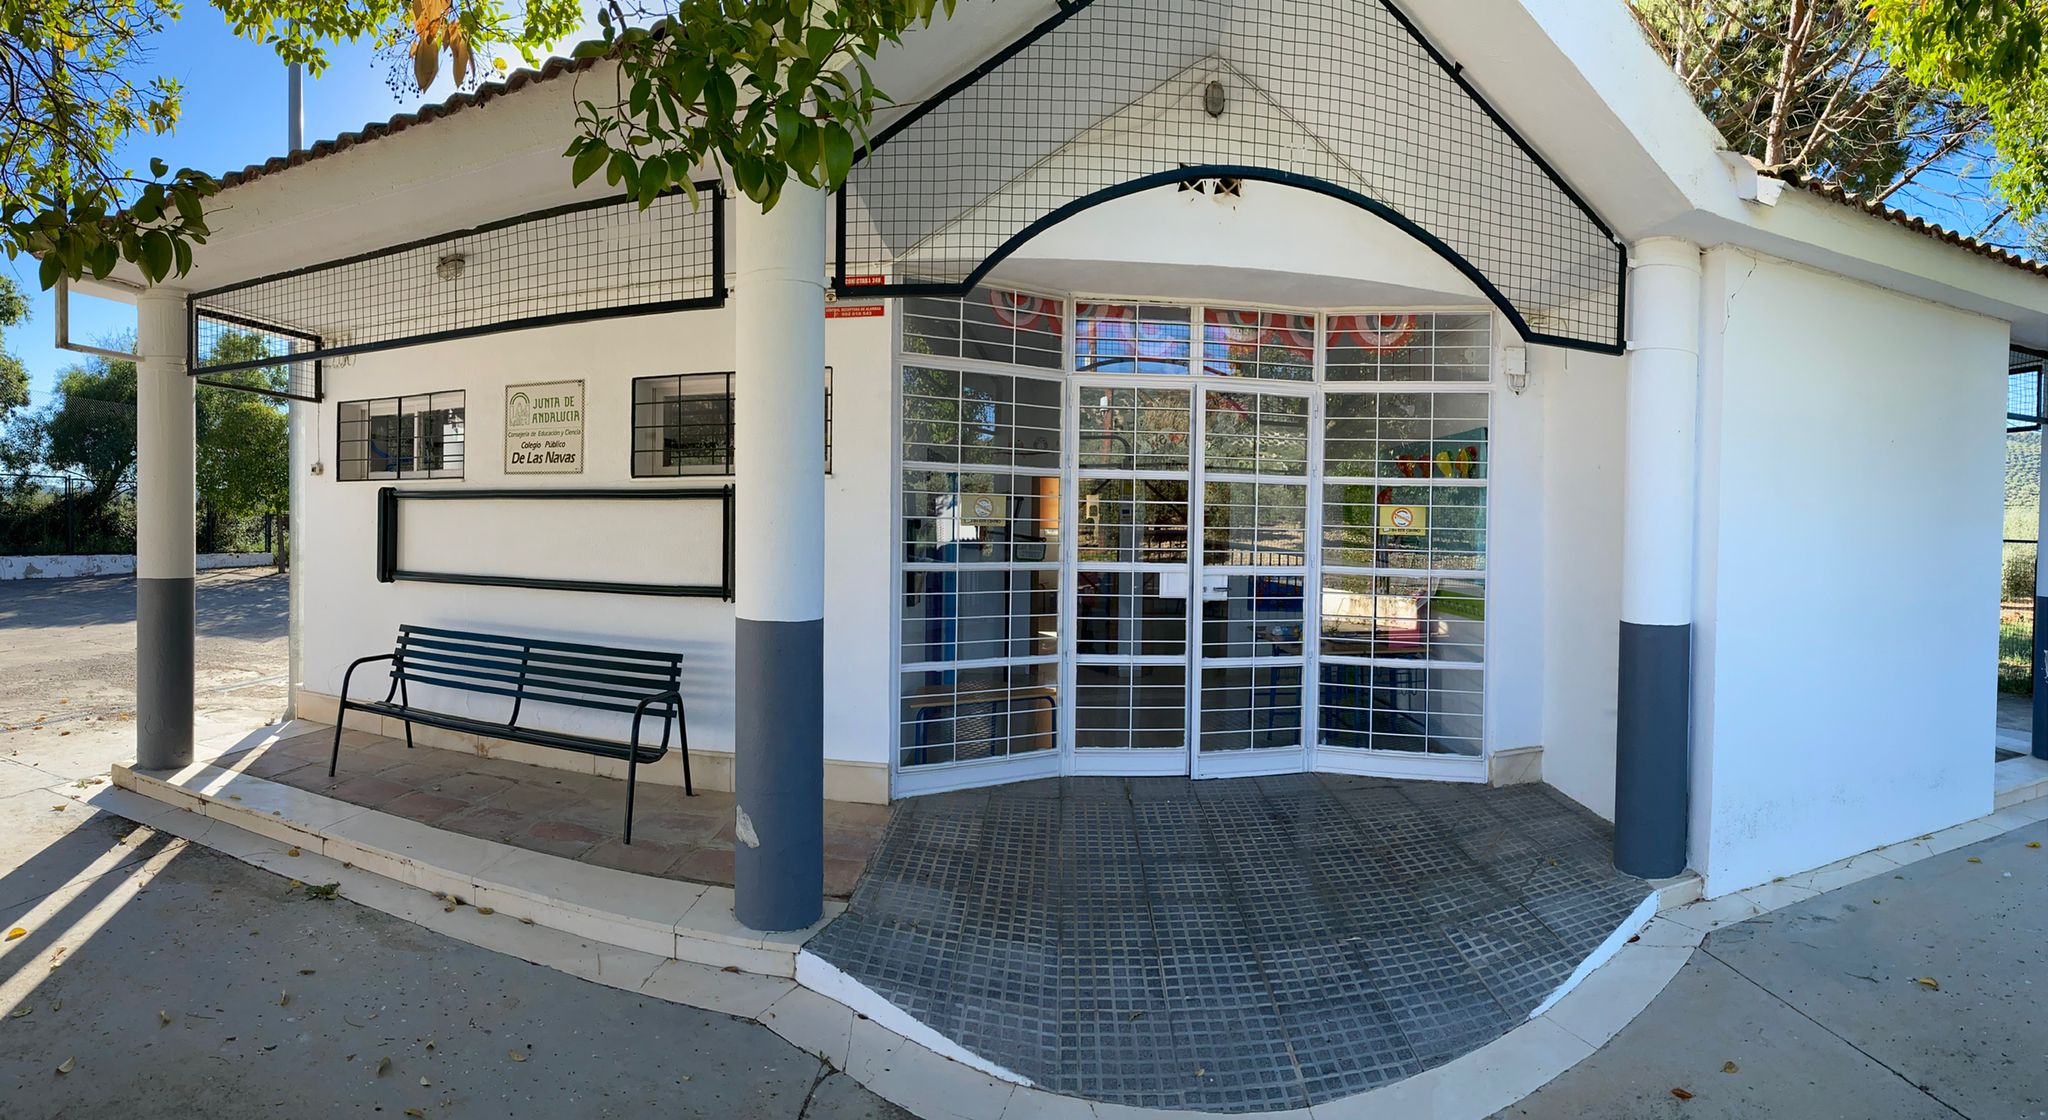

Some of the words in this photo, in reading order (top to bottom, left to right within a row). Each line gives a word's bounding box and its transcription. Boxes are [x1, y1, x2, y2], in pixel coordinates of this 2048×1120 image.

[532, 397, 560, 409] JUNTA
[564, 396, 575, 407] DE
[532, 411, 580, 423] ANDALUCIA
[521, 441, 542, 450] Colegio
[545, 440, 566, 448] Público
[511, 452, 525, 464] De
[527, 452, 543, 464] Las
[545, 451, 576, 464] Navas
